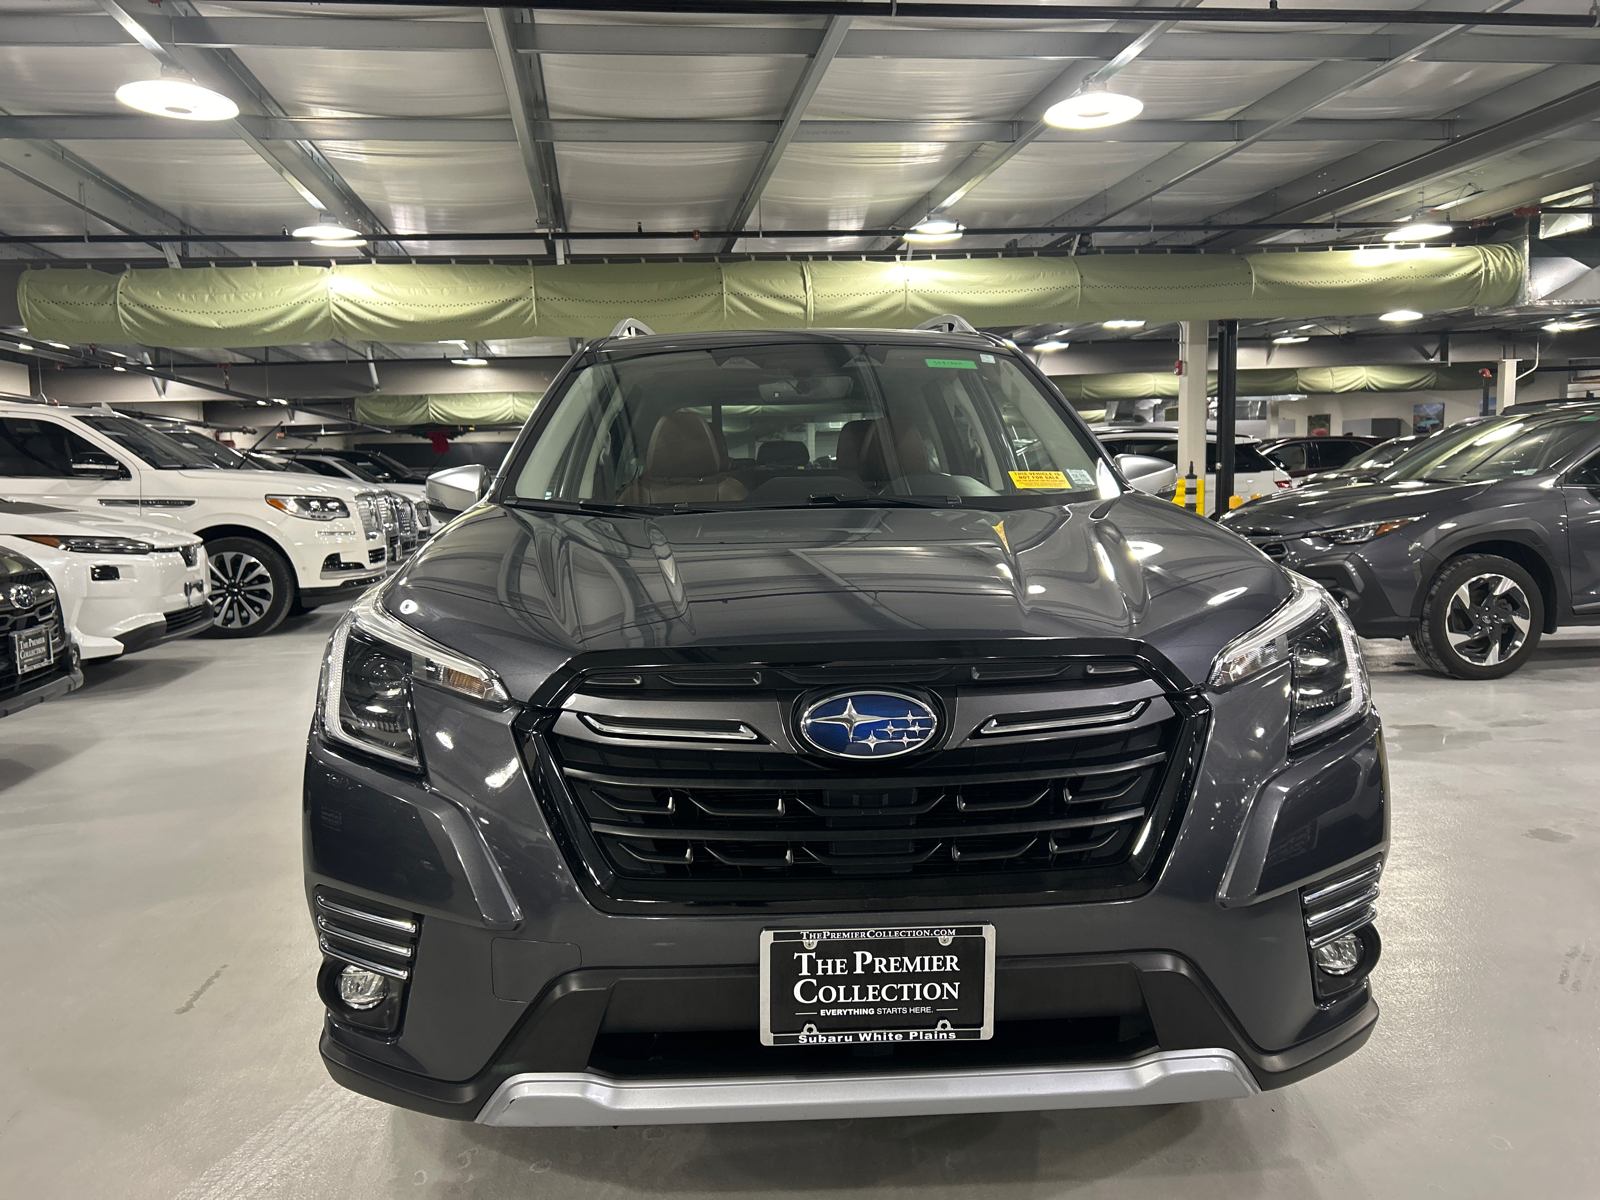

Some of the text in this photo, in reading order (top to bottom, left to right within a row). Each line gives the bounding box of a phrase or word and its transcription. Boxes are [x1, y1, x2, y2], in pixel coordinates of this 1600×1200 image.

[794, 951, 960, 976] THE PREMIER
[793, 978, 961, 1004] COLLECTION
[820, 1006, 934, 1016] EVERYTHING STARTS HERE.
[798, 1031, 957, 1044] Subaru White Plains
